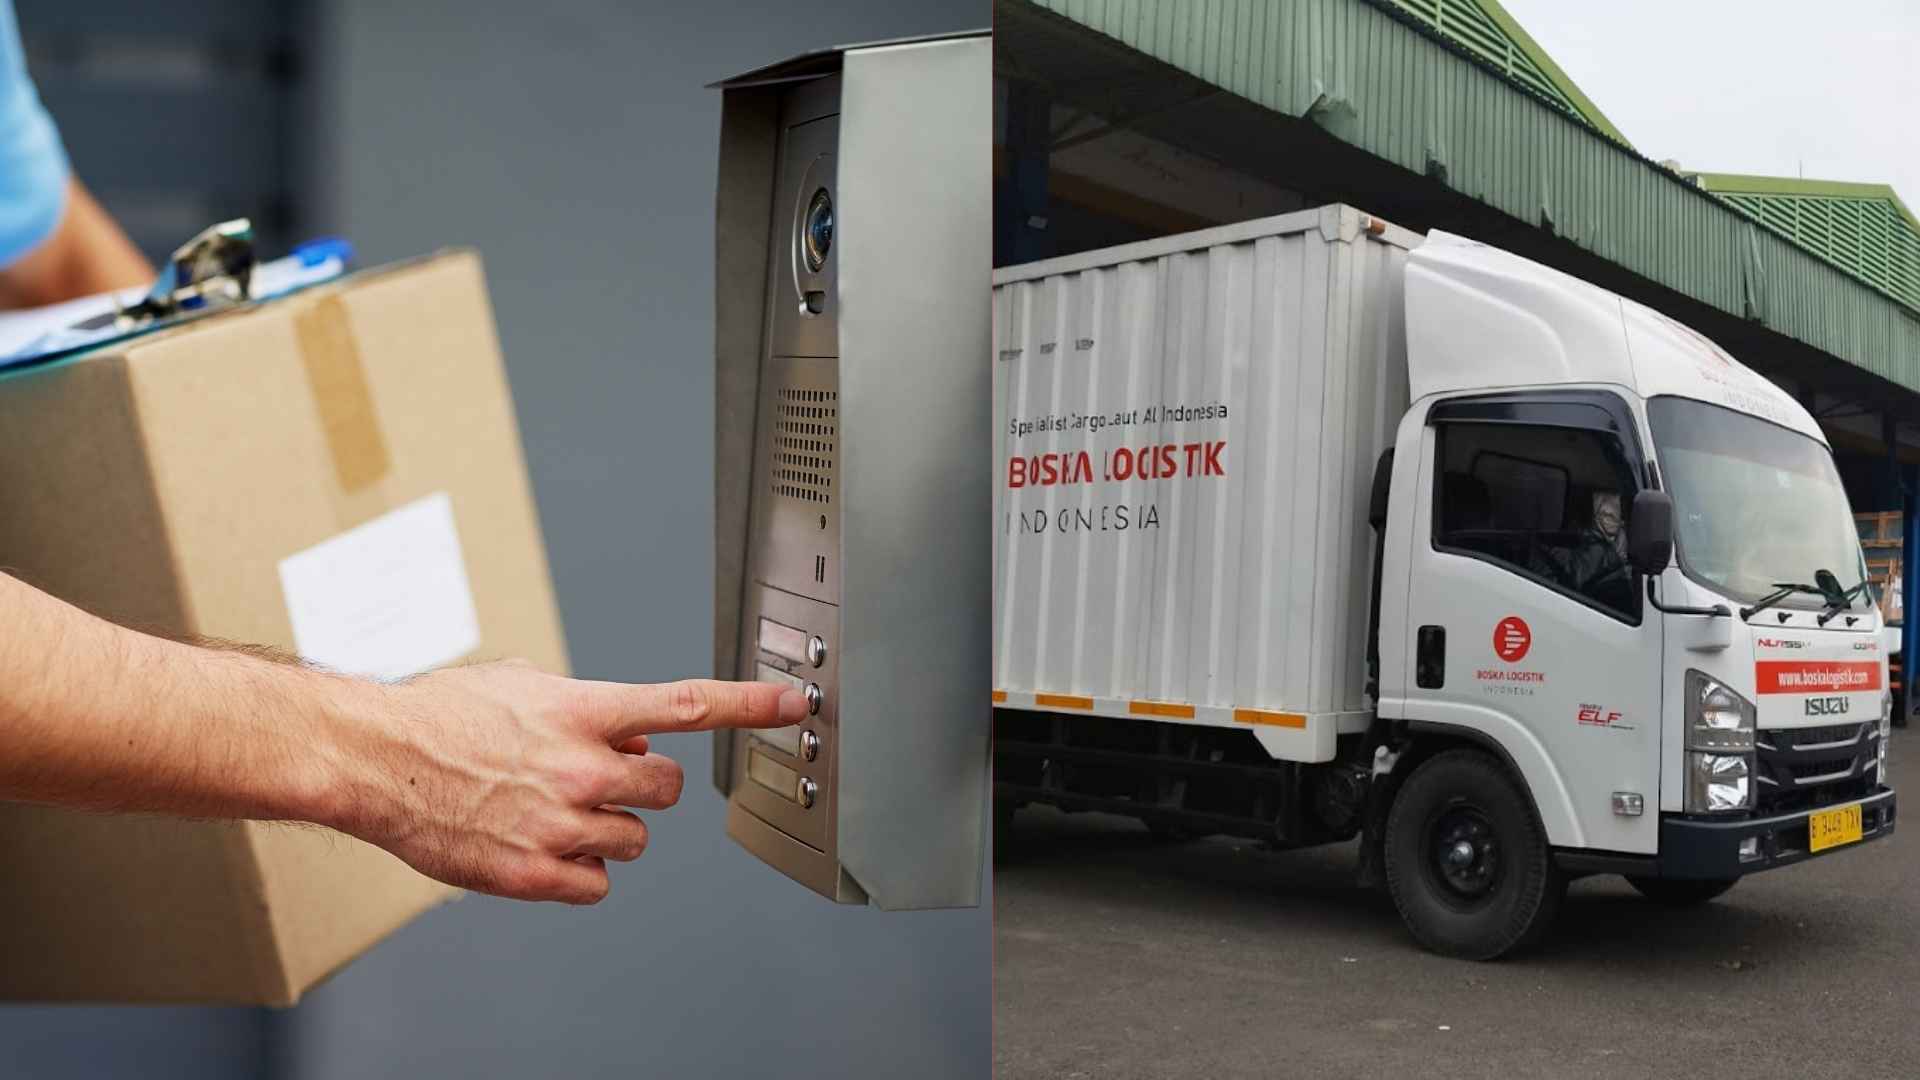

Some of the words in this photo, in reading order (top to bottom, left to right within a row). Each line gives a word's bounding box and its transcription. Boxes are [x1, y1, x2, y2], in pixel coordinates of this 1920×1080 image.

[1010, 416, 1067, 437] Speialist
[1162, 402, 1228, 422] Indonesia
[1008, 451, 1093, 487] BOSKA
[1006, 504, 1160, 535] INDONESIA
[1477, 671, 1504, 681] BOSKA
[1506, 672, 1544, 682] LOGISTIK
[1578, 710, 1622, 723] ELF
[1805, 697, 1848, 715] ISUZU
